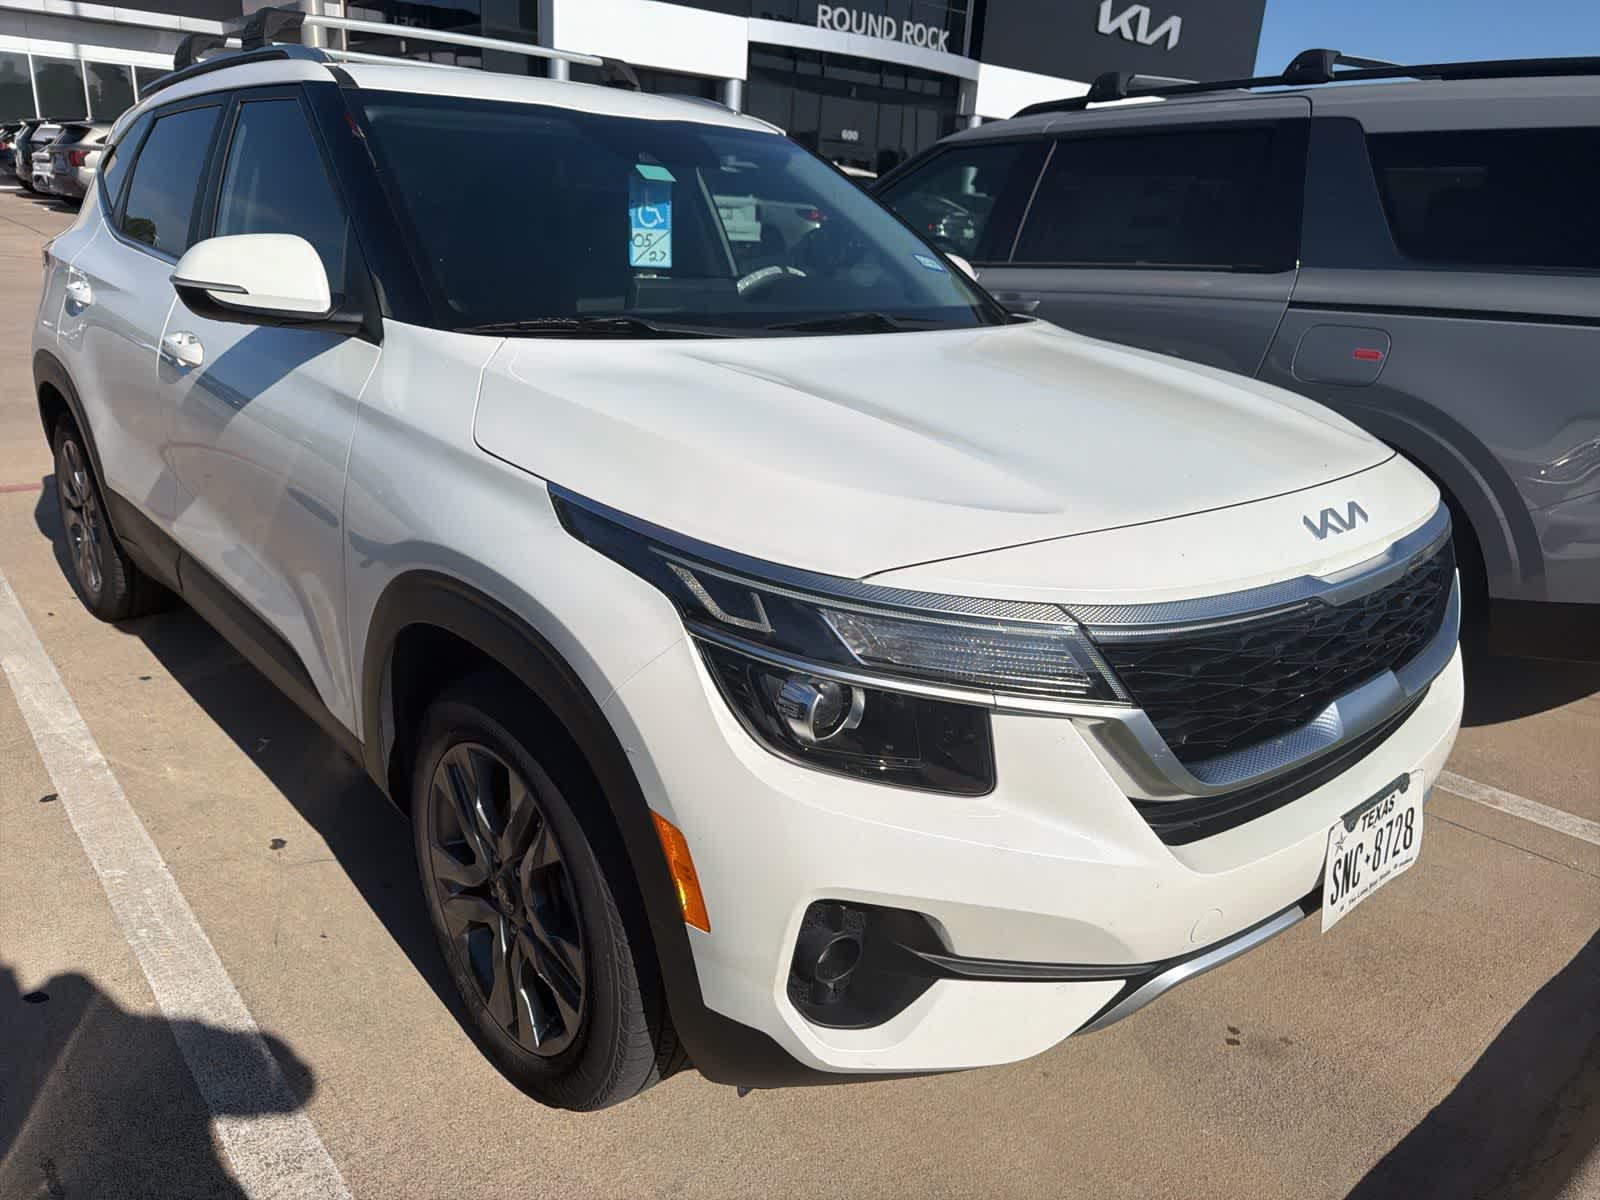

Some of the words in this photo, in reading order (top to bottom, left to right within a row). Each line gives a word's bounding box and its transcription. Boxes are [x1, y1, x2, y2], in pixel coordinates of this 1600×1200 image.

[816, 4, 897, 40] ROUND
[902, 20, 951, 53] ROCK
[1097, 0, 1182, 51] KIA
[841, 129, 859, 141] 600
[1303, 500, 1369, 540] KIA
[1361, 795, 1396, 832] TEXAS
